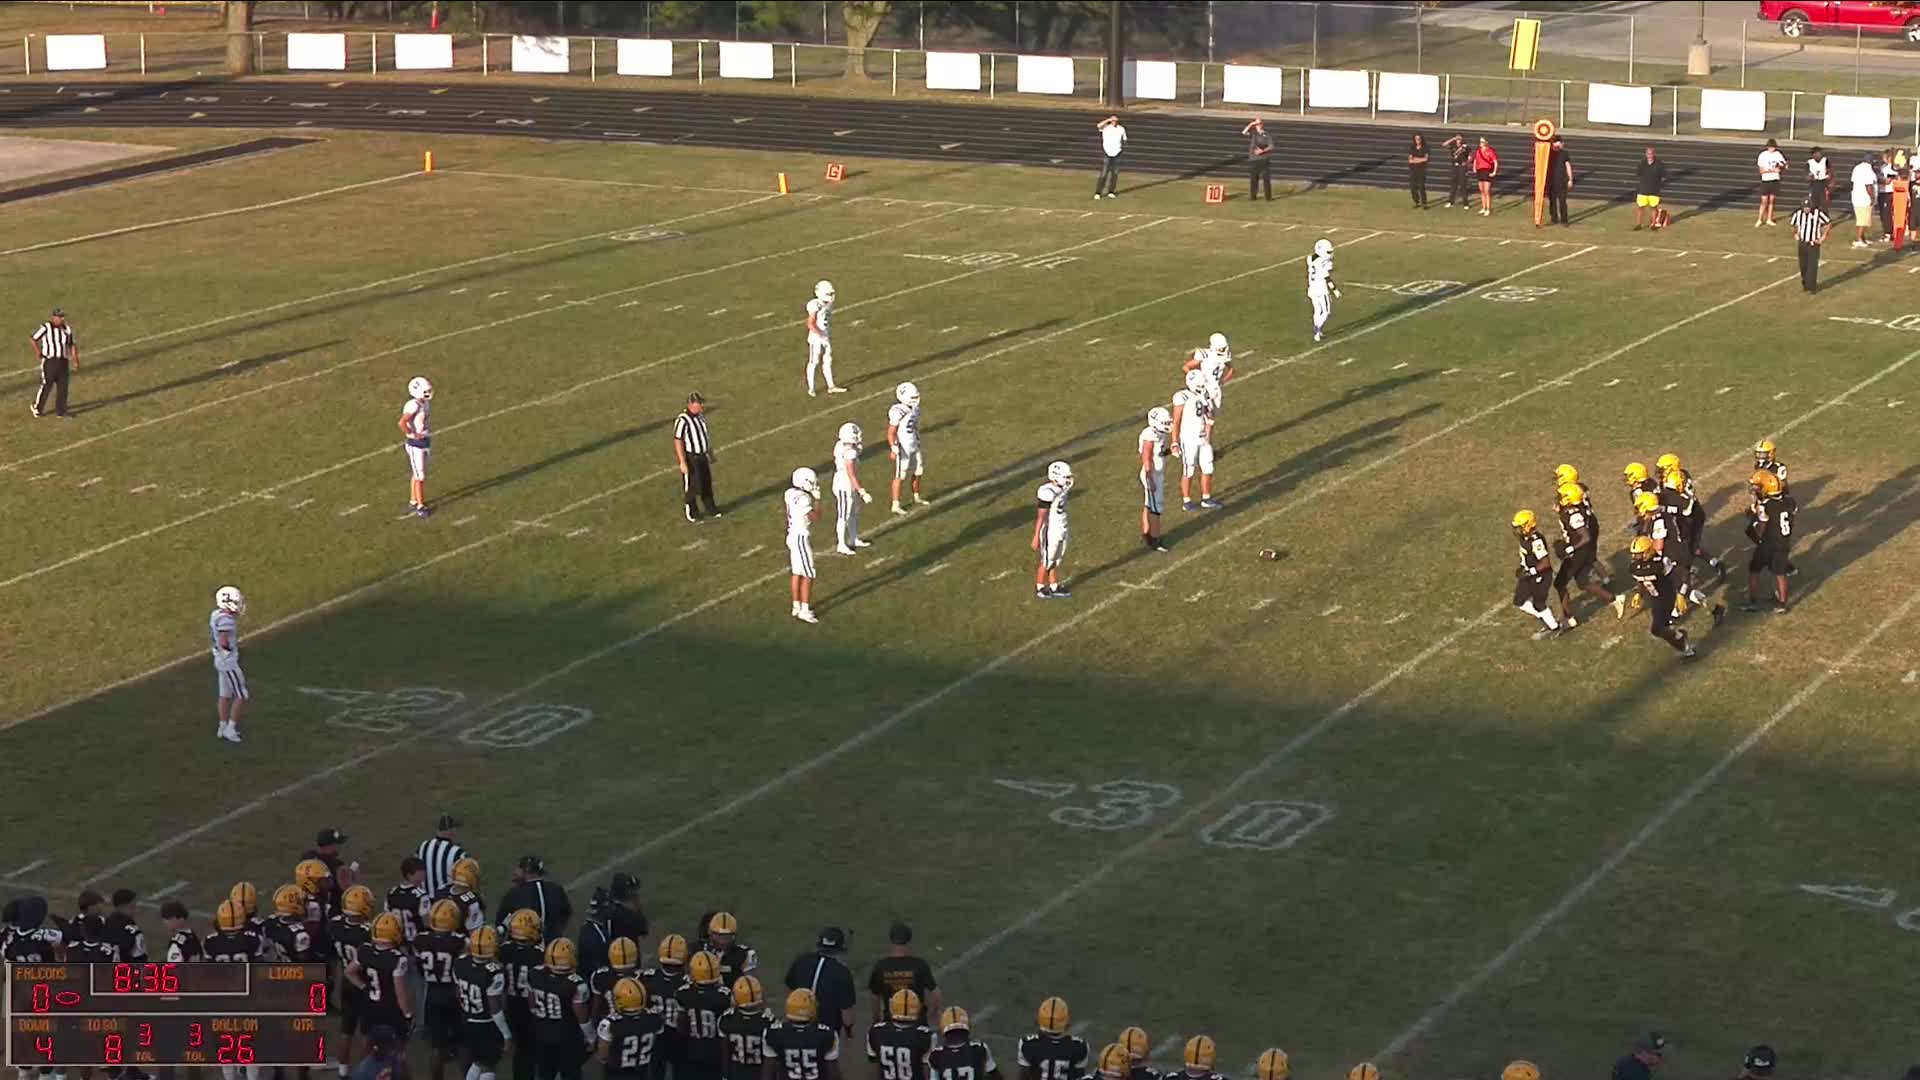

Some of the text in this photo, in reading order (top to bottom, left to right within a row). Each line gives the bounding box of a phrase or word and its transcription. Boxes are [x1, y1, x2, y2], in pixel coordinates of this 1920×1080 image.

[1209, 187, 1221, 200] 10
[1780, 511, 1791, 536] 6
[419, 951, 453, 983] 27
[366, 967, 381, 1001] 3
[458, 979, 484, 1014] 59
[530, 988, 562, 1019] 50
[688, 1008, 716, 1039] 18
[621, 1032, 655, 1068] 22
[785, 1049, 819, 1080] 55
[880, 1045, 913, 1080] 58
